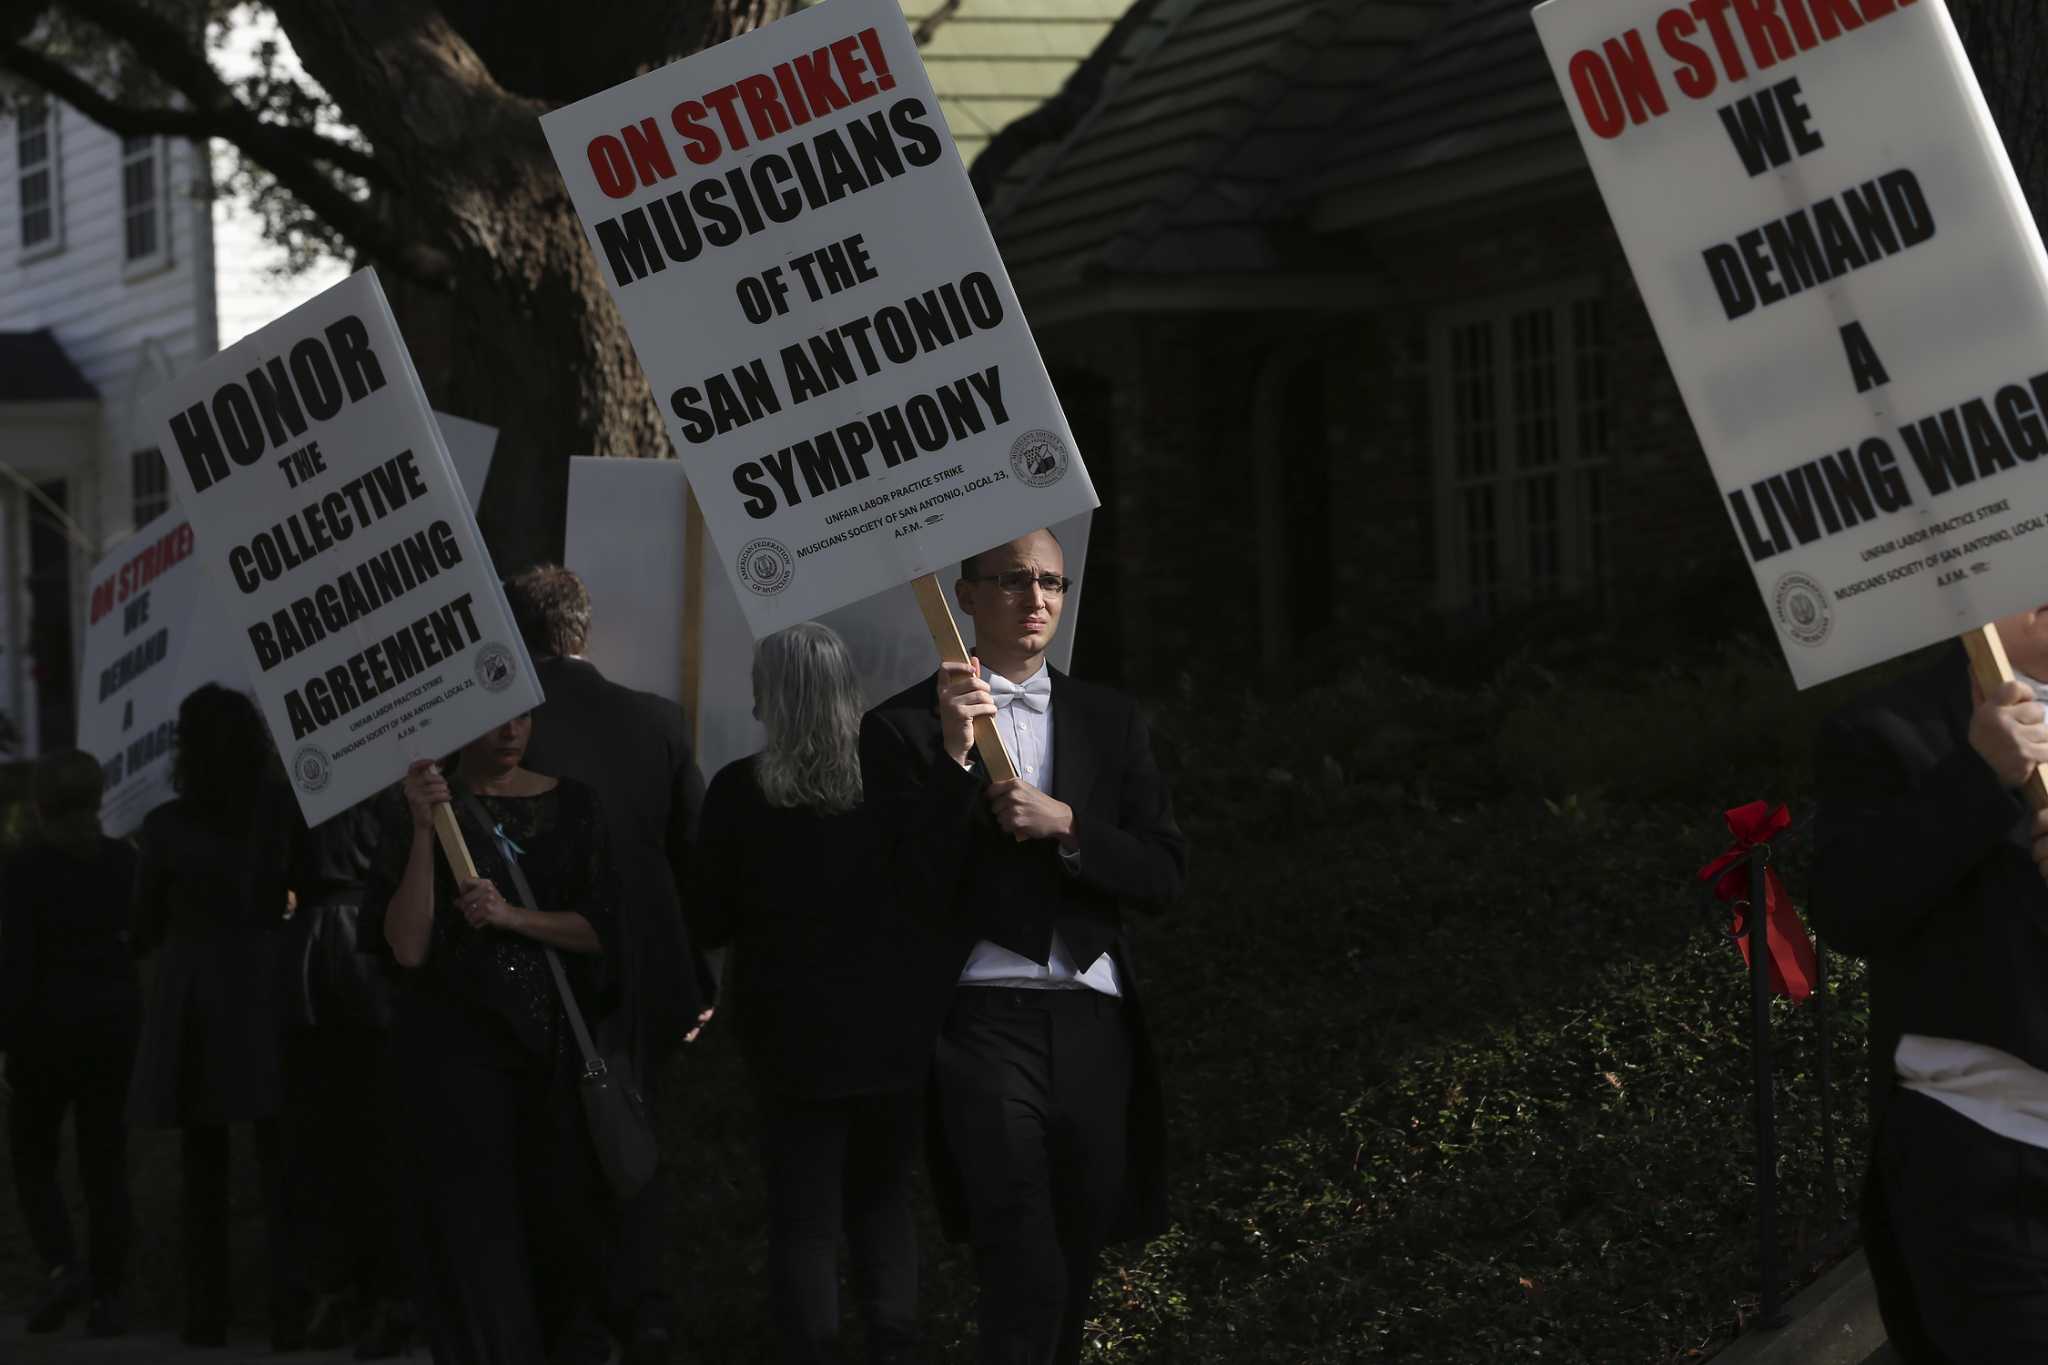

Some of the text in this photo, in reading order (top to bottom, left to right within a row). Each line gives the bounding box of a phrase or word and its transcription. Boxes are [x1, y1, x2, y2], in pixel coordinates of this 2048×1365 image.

[587, 27, 896, 199] ON STRIKE!
[1568, 28, 1670, 140] ON
[1717, 76, 1825, 178] WE
[595, 98, 942, 287] MUSICIANS
[736, 233, 879, 324] OF THE
[1702, 168, 1936, 320] DEMAND
[169, 315, 387, 493] HONOR
[670, 272, 1003, 443] SAN ANTONIO
[1839, 320, 1890, 393] A
[278, 441, 327, 489] THE
[733, 365, 1010, 519] SYMPHONY
[229, 449, 428, 594] COLLECTIVE
[797, 470, 1009, 558] MUSICIANS SOCIETY OF SAN ANTONIO, LOCAL 23,
[825, 464, 965, 525] UNFAIR LABOR PRACTICE STRIKE
[894, 522, 922, 539] A.F.M.
[1727, 437, 1913, 562] LIVING
[1860, 499, 2010, 562] UNFAIR LABOR PRACTICE STRIKE
[90, 573, 115, 625] ON
[248, 520, 463, 672] BARGAINING
[1834, 574, 1887, 600] MUSICIANS
[1886, 560, 1925, 581] SOCIETY
[1925, 554, 1939, 568] OF
[1940, 547, 1962, 563] SAN
[1963, 529, 2012, 554] ANTONIO,
[2012, 517, 2044, 536] LOCAL
[124, 590, 150, 636] WE
[99, 627, 168, 704] DEMAND
[284, 592, 481, 741] AGREEMENT
[122, 699, 133, 732] A
